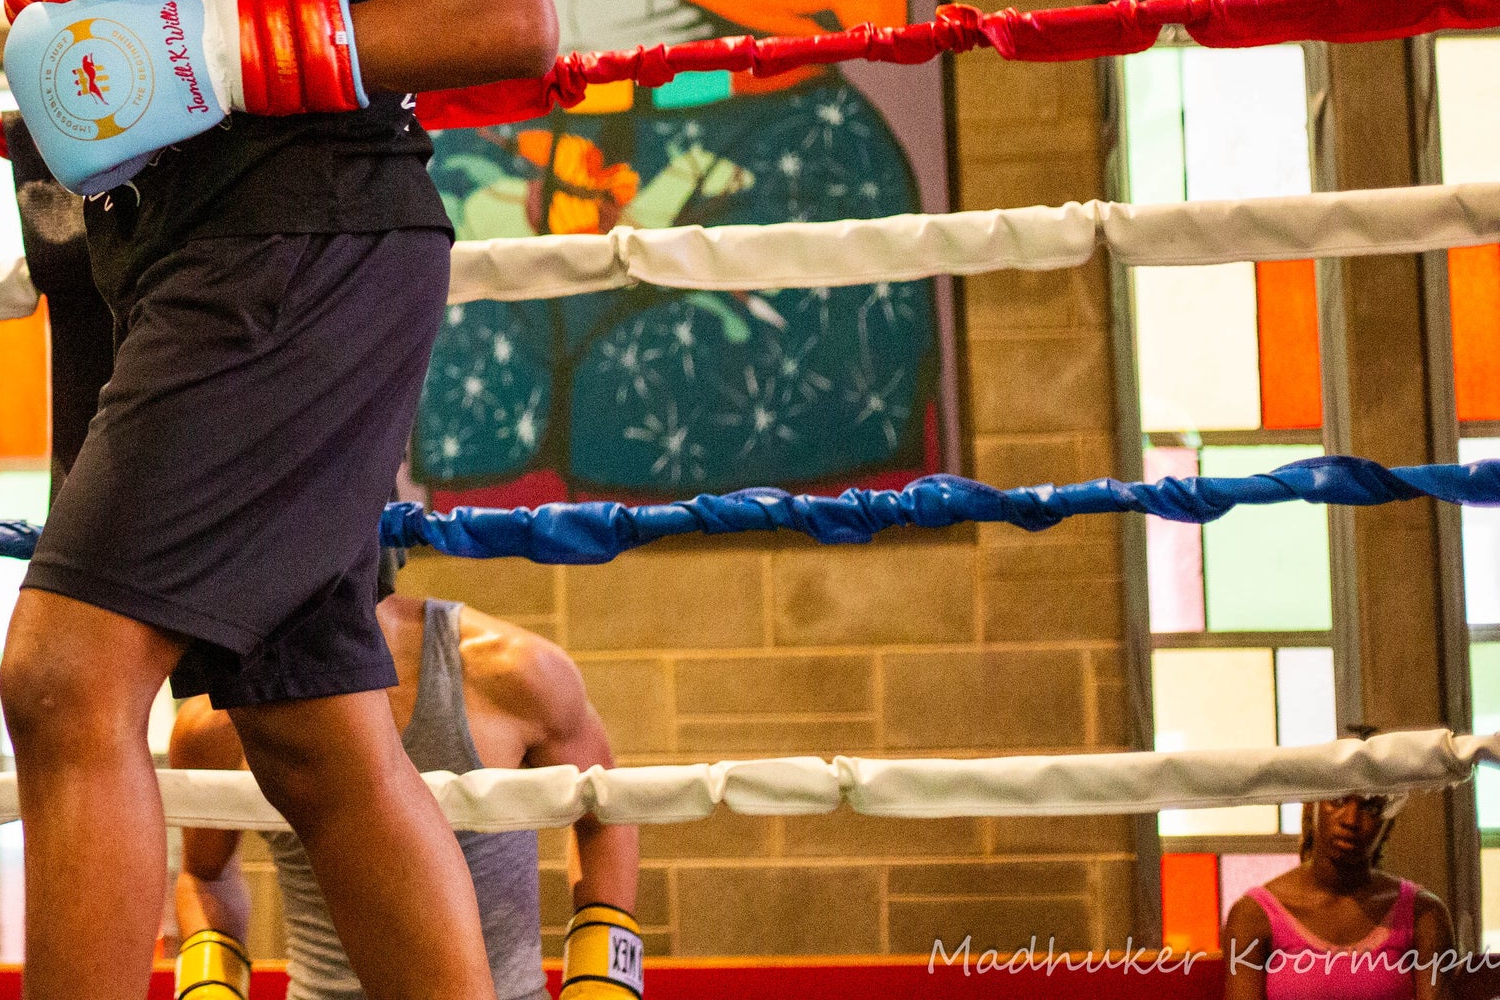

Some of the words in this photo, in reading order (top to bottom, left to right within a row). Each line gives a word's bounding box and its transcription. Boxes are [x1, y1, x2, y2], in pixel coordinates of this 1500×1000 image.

[160, 0, 185, 46] Willis
[50, 37, 68, 63] JUST
[46, 88, 92, 134] IMPOSSIBLE
